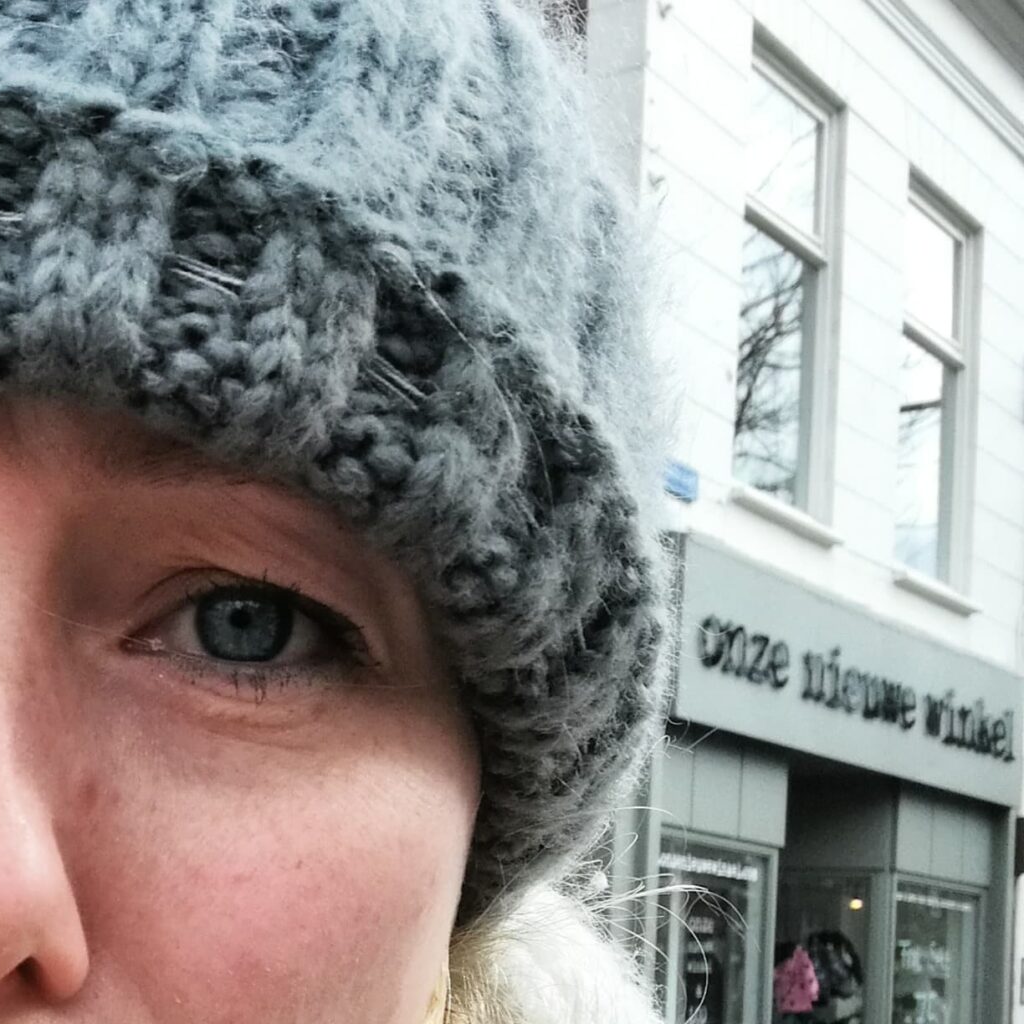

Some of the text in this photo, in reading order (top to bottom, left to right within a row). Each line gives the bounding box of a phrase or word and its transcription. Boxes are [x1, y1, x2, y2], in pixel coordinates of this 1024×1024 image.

[698, 614, 1016, 763] onze nieuwe winkel
